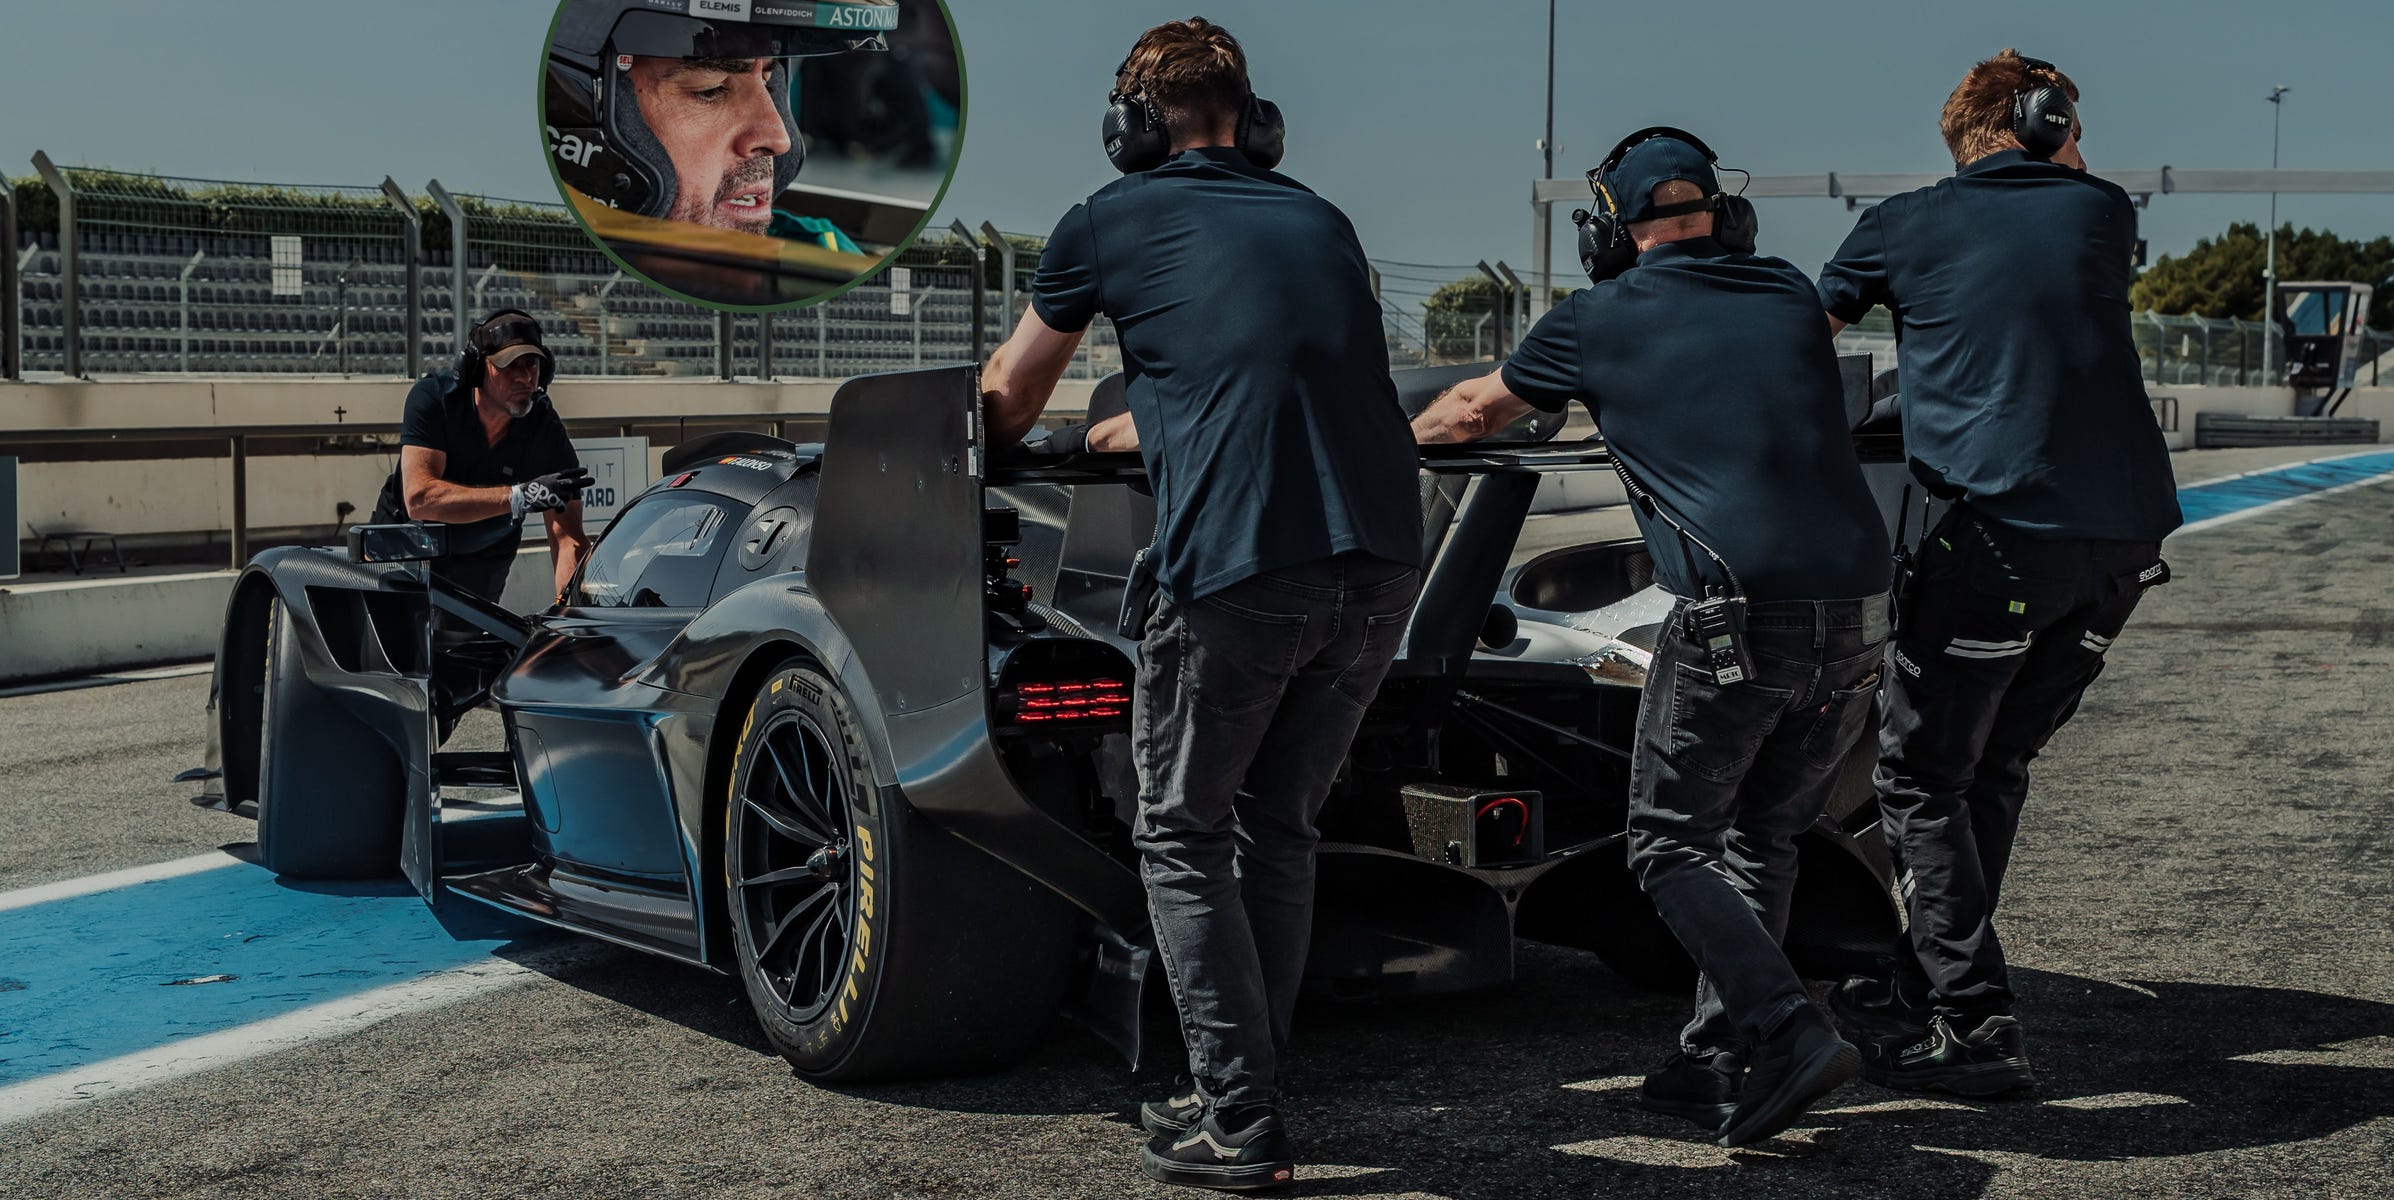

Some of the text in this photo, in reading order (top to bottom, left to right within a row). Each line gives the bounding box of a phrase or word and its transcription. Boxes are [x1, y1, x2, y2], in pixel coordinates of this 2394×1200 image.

[700, 0, 741, 13] ELEMIS
[754, 6, 813, 18] GLENFIDDICH
[829, 6, 882, 28] ASTON
[581, 487, 615, 508] ARD
[839, 826, 874, 1024] PIRELLI
